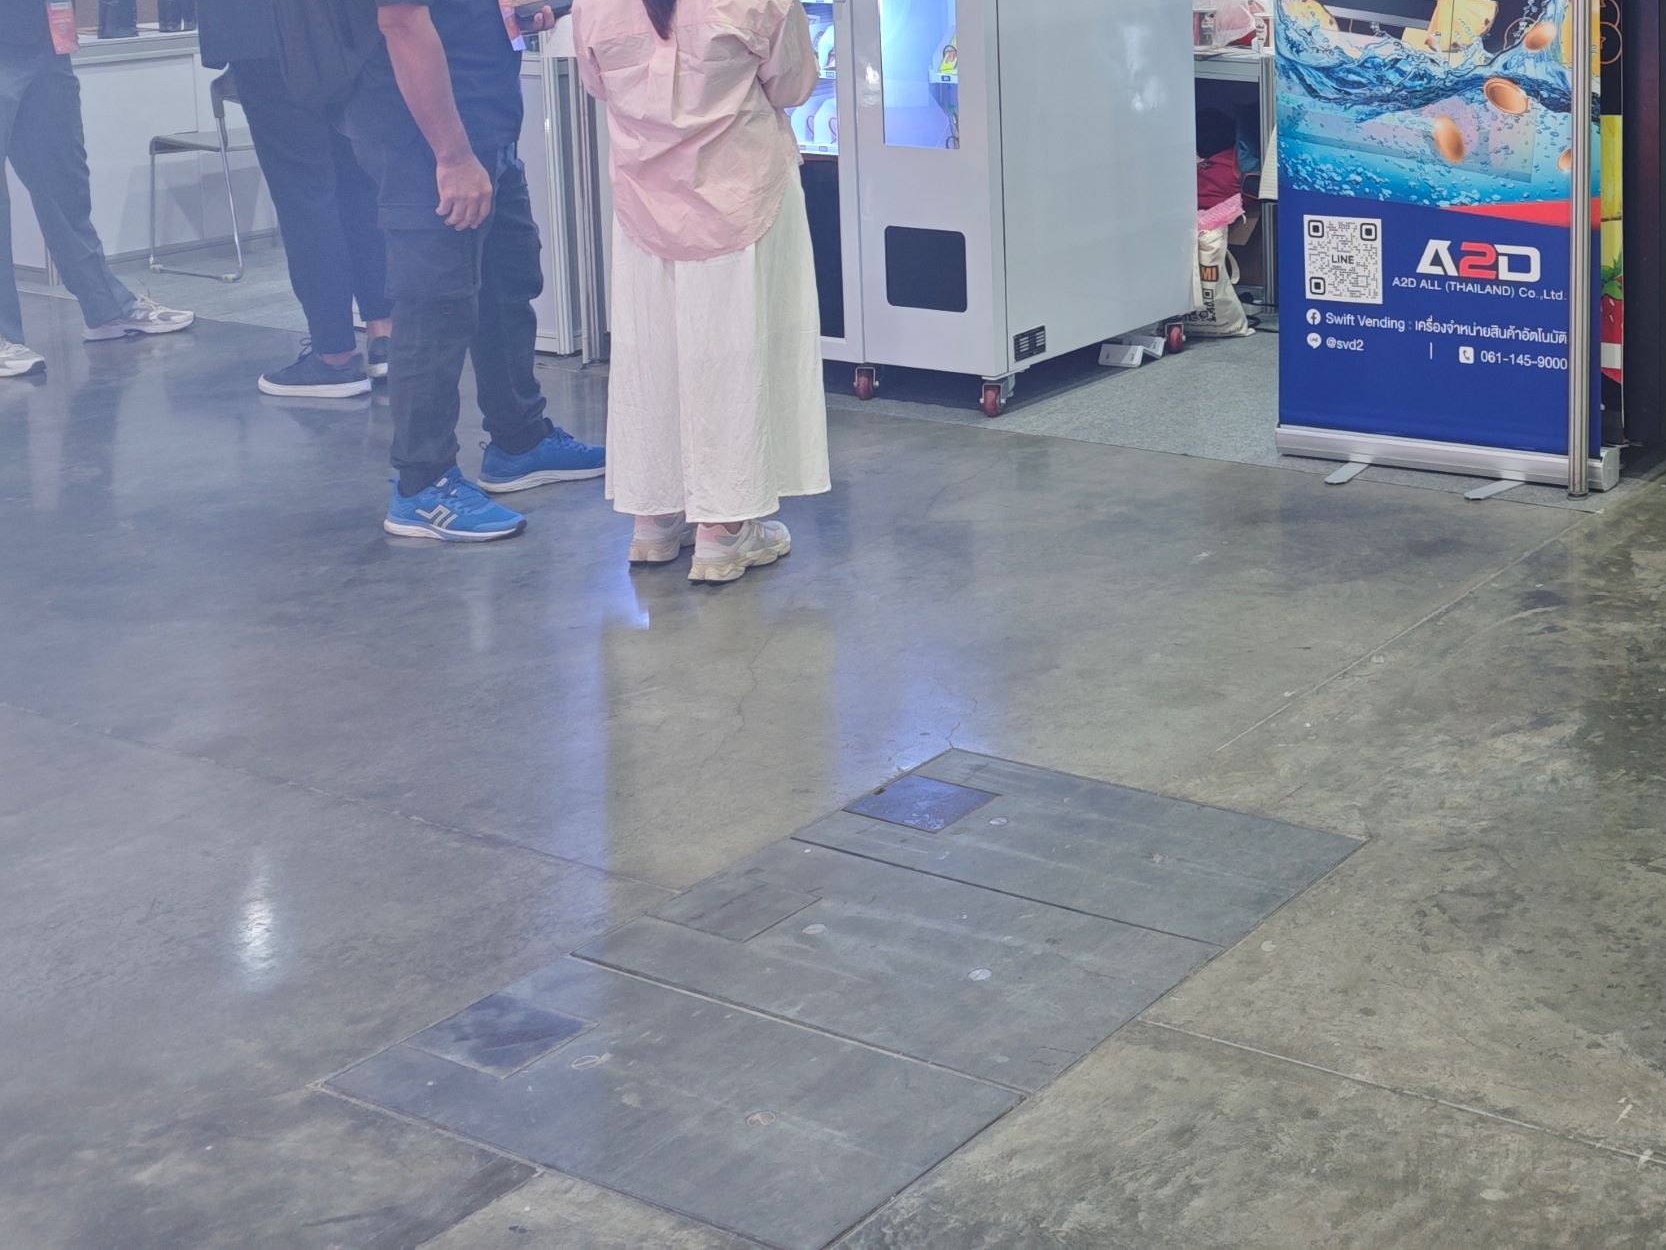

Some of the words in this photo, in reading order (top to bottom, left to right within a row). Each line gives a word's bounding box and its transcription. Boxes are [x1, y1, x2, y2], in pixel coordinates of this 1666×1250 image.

[1331, 253, 1355, 265] LINE
[1415, 238, 1542, 284] A2D
[1391, 276, 1417, 288] A2D
[1419, 279, 1442, 291] ALL
[1445, 281, 1515, 299] (THAILAND)
[1325, 312, 1356, 326] Swift
[1357, 314, 1406, 332] Vending
[1414, 314, 1568, 345] เครื่องจำหน่ายสินค้าอัตโนมัติ
[1326, 336, 1364, 351] @svd2
[1480, 350, 1568, 371] 061-145-9000
